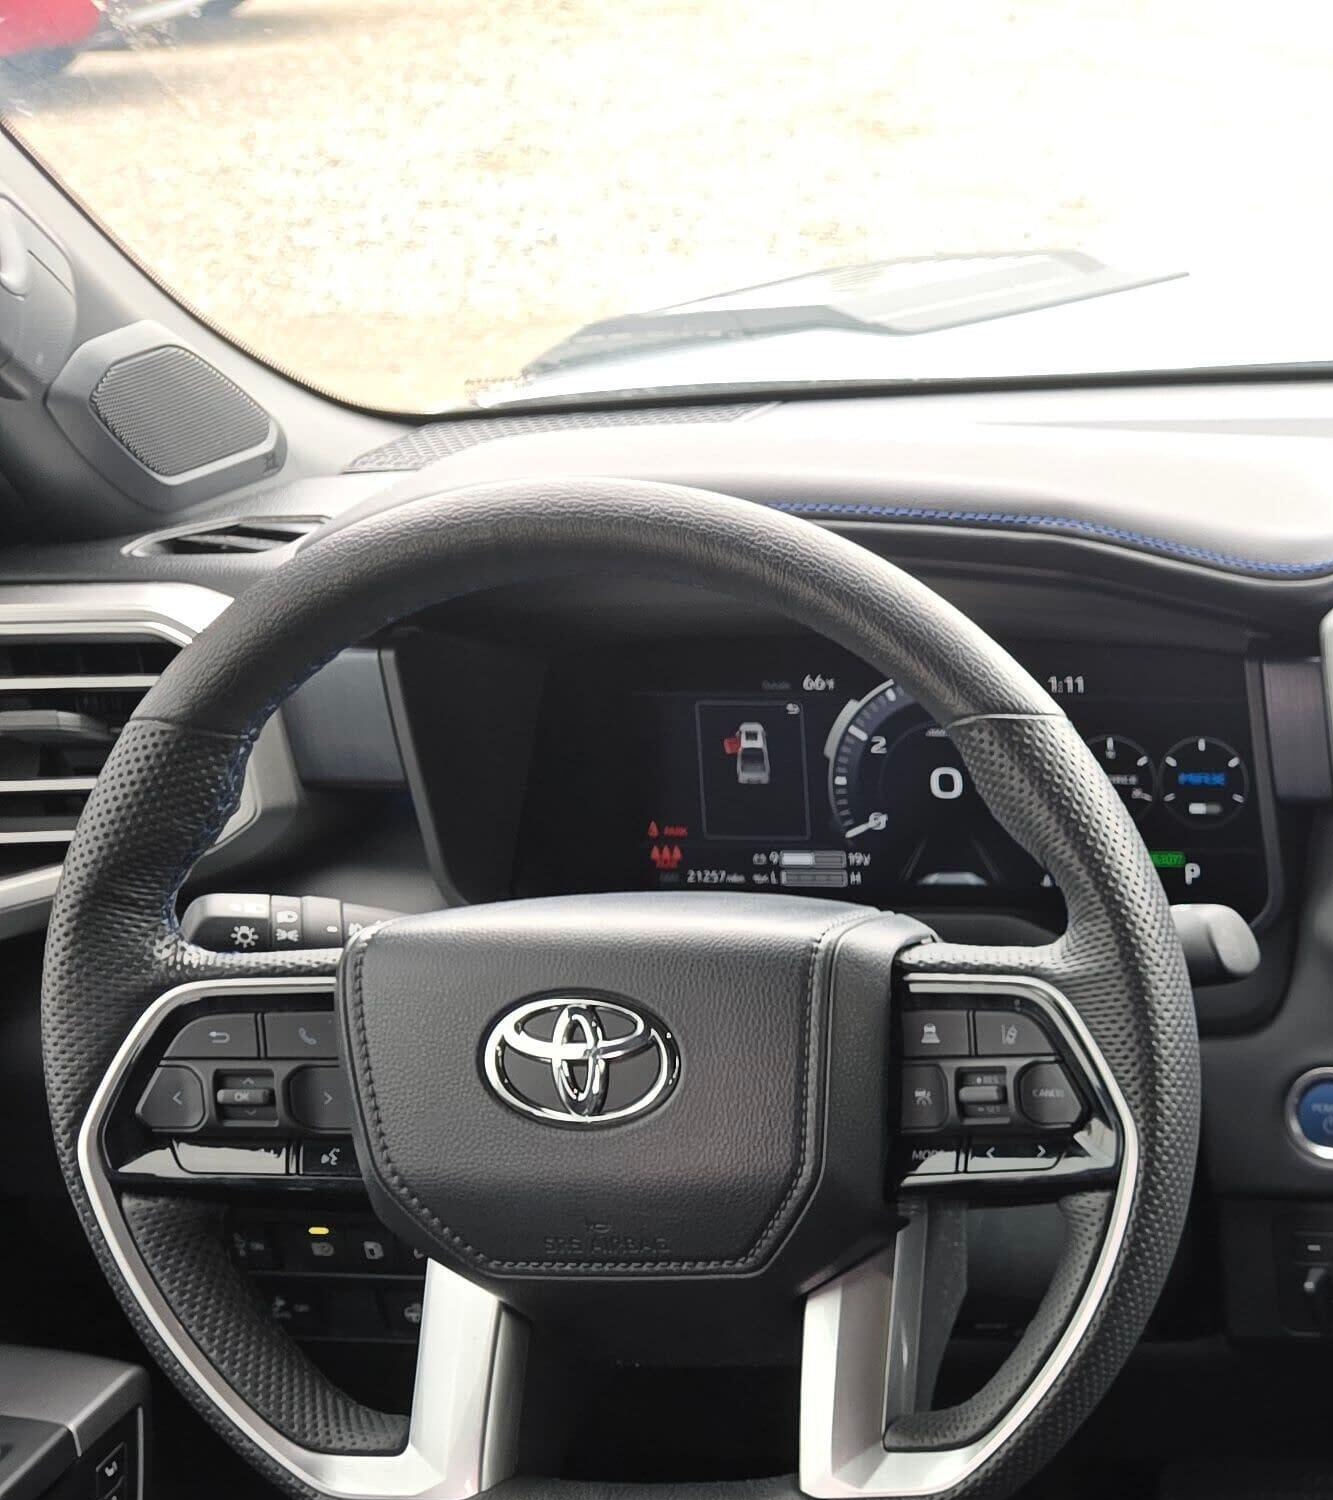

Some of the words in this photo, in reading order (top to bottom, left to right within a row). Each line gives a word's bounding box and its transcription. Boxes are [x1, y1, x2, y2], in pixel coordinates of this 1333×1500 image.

[870, 735, 888, 754] 2
[930, 766, 964, 800] 0
[1184, 863, 1201, 886] P
